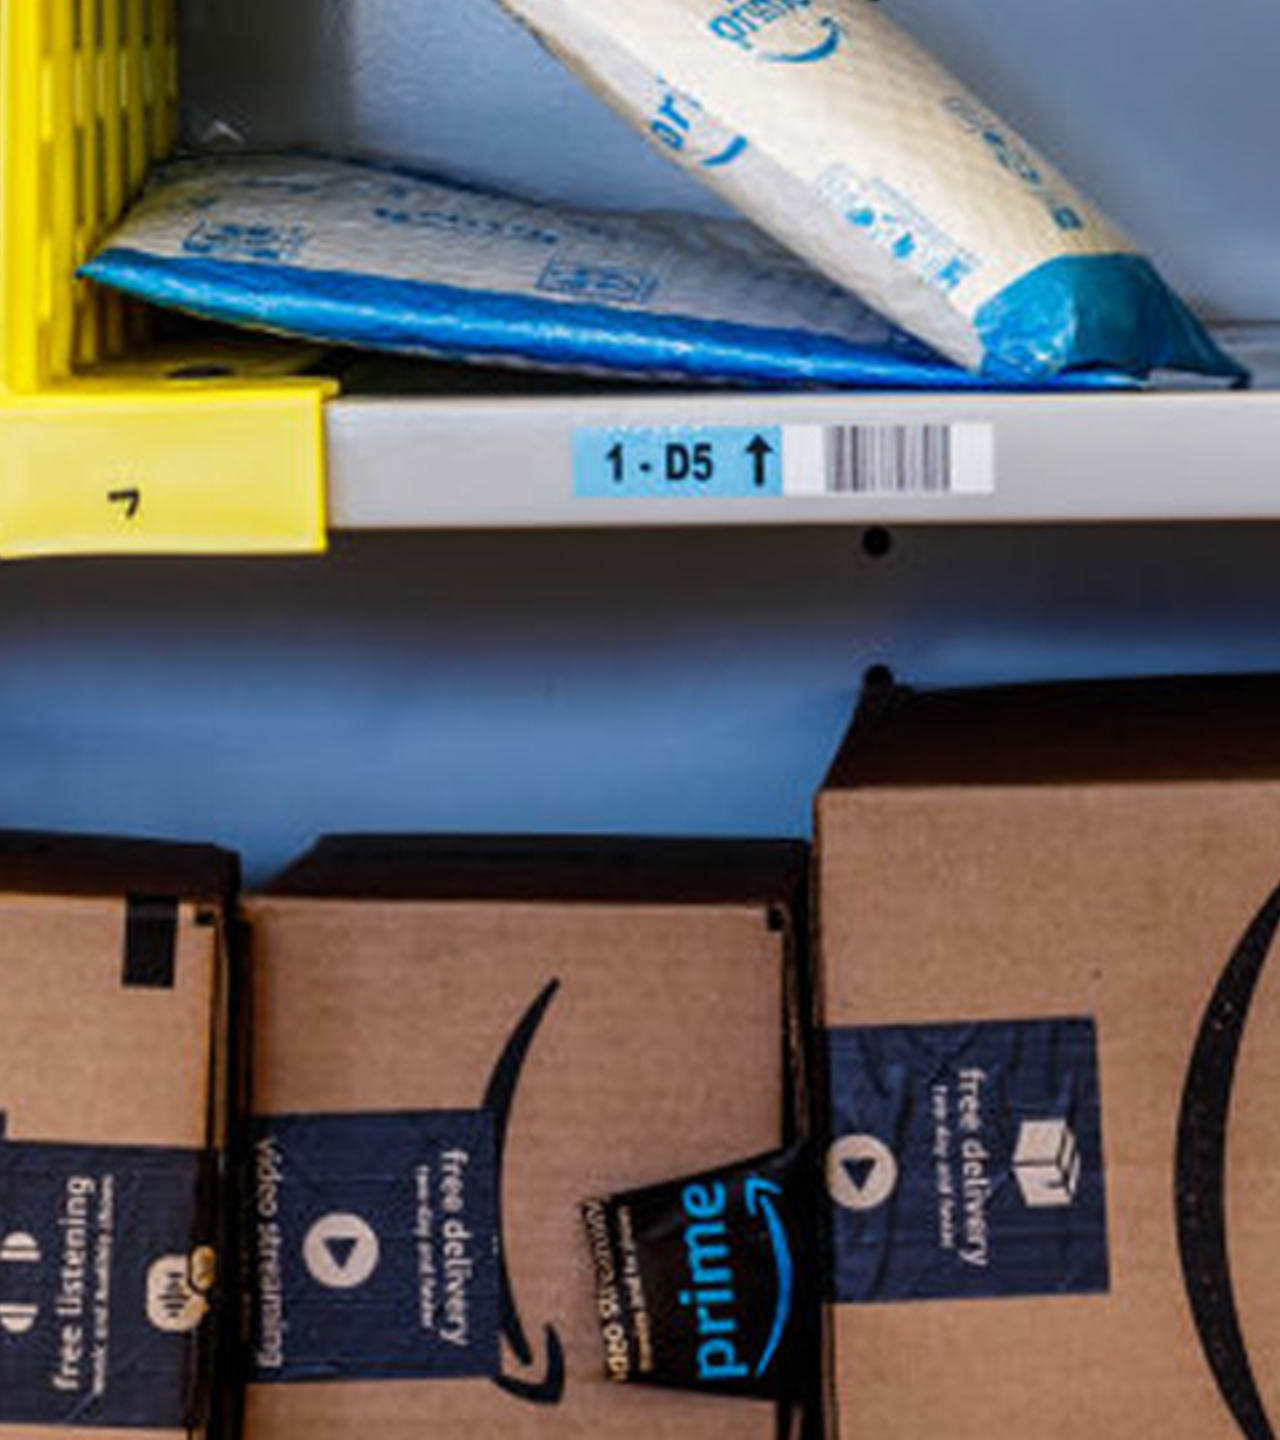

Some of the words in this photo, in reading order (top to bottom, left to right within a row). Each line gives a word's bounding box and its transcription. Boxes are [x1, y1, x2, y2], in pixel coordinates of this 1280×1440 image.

[958, 1068, 986, 1130] free
[256, 1137, 282, 1216] video
[441, 1149, 468, 1212] free
[959, 1139, 991, 1266] delivery
[55, 1176, 94, 1315] listening
[257, 1223, 287, 1368] streaming
[441, 1220, 474, 1347] delivery
[678, 1181, 749, 1380] prime
[53, 1324, 84, 1390] free
